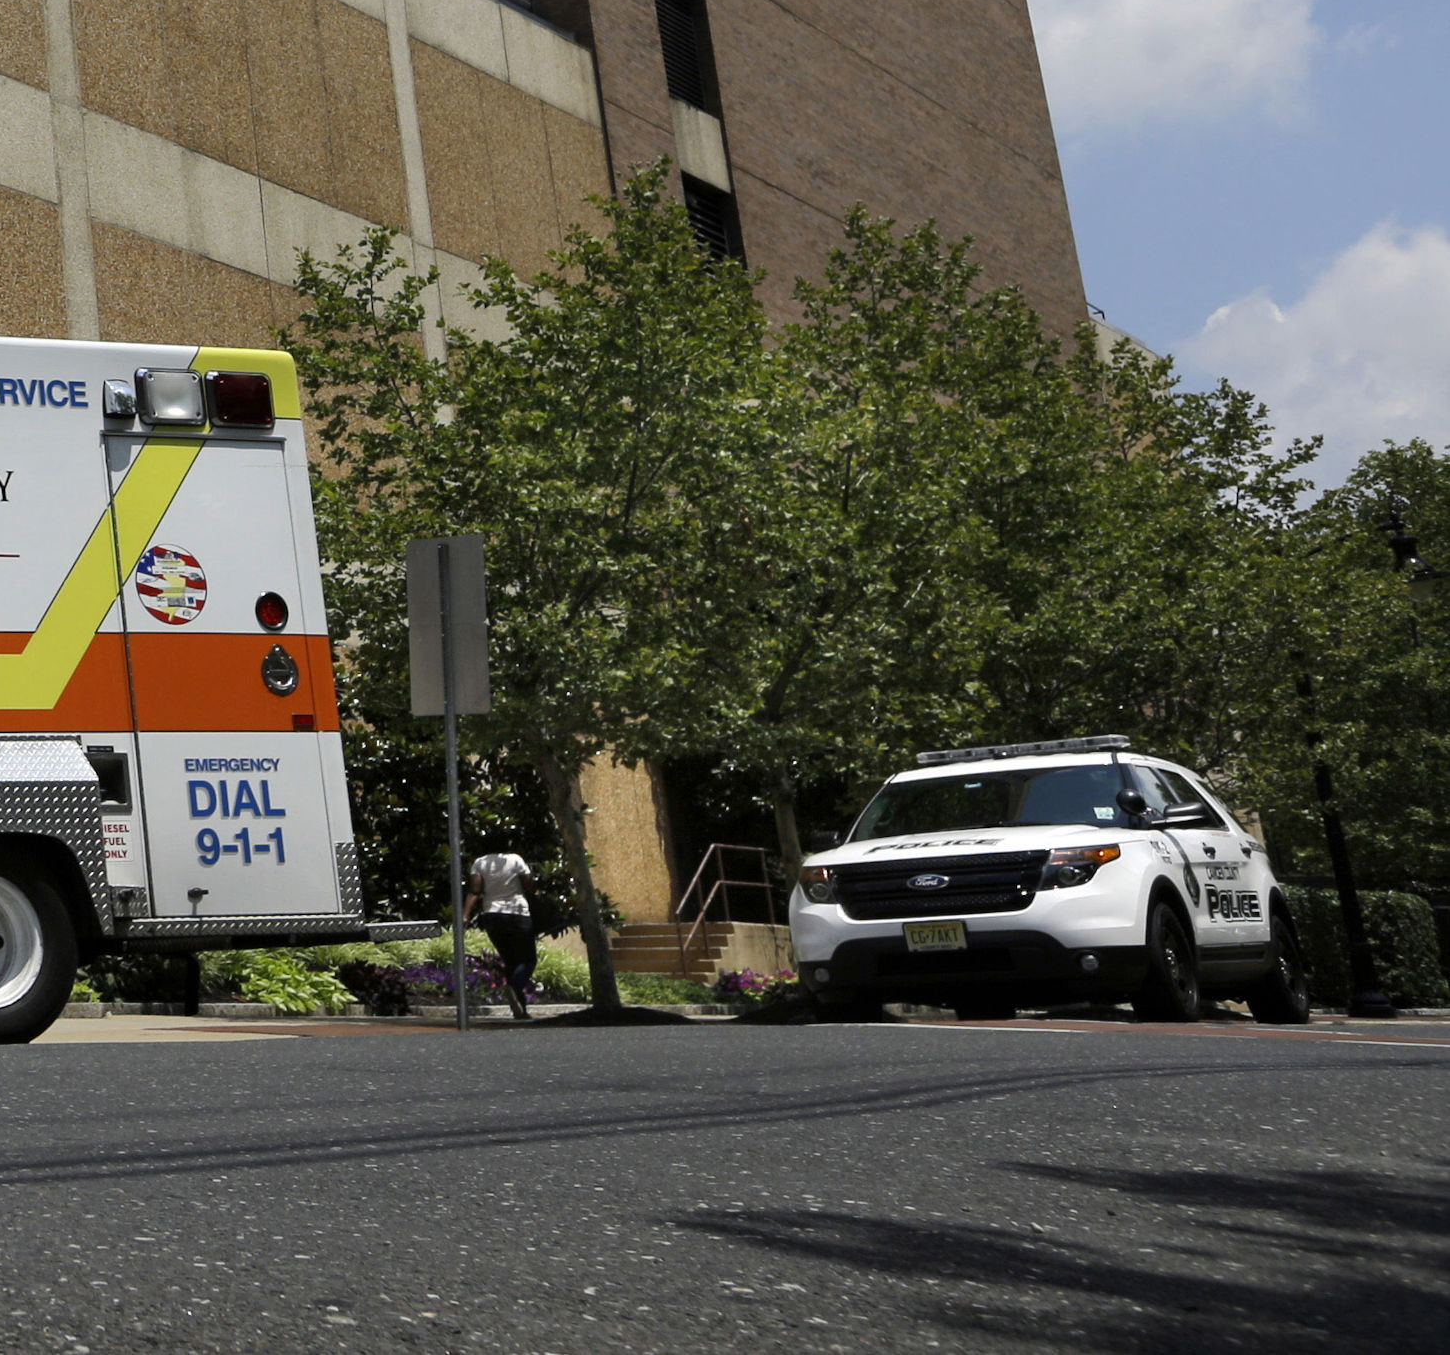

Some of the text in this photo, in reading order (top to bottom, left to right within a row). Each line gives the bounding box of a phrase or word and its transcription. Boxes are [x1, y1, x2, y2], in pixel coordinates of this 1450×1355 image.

[184, 758, 280, 772] EMERGENCY
[187, 779, 287, 818] DIAL
[103, 824, 130, 833] IESEL
[103, 837, 127, 846] FUEL
[196, 827, 286, 866] 9-1-1
[862, 838, 1005, 856] POLICE
[104, 850, 128, 859] ONLY
[1204, 883, 1263, 923] POLICE
